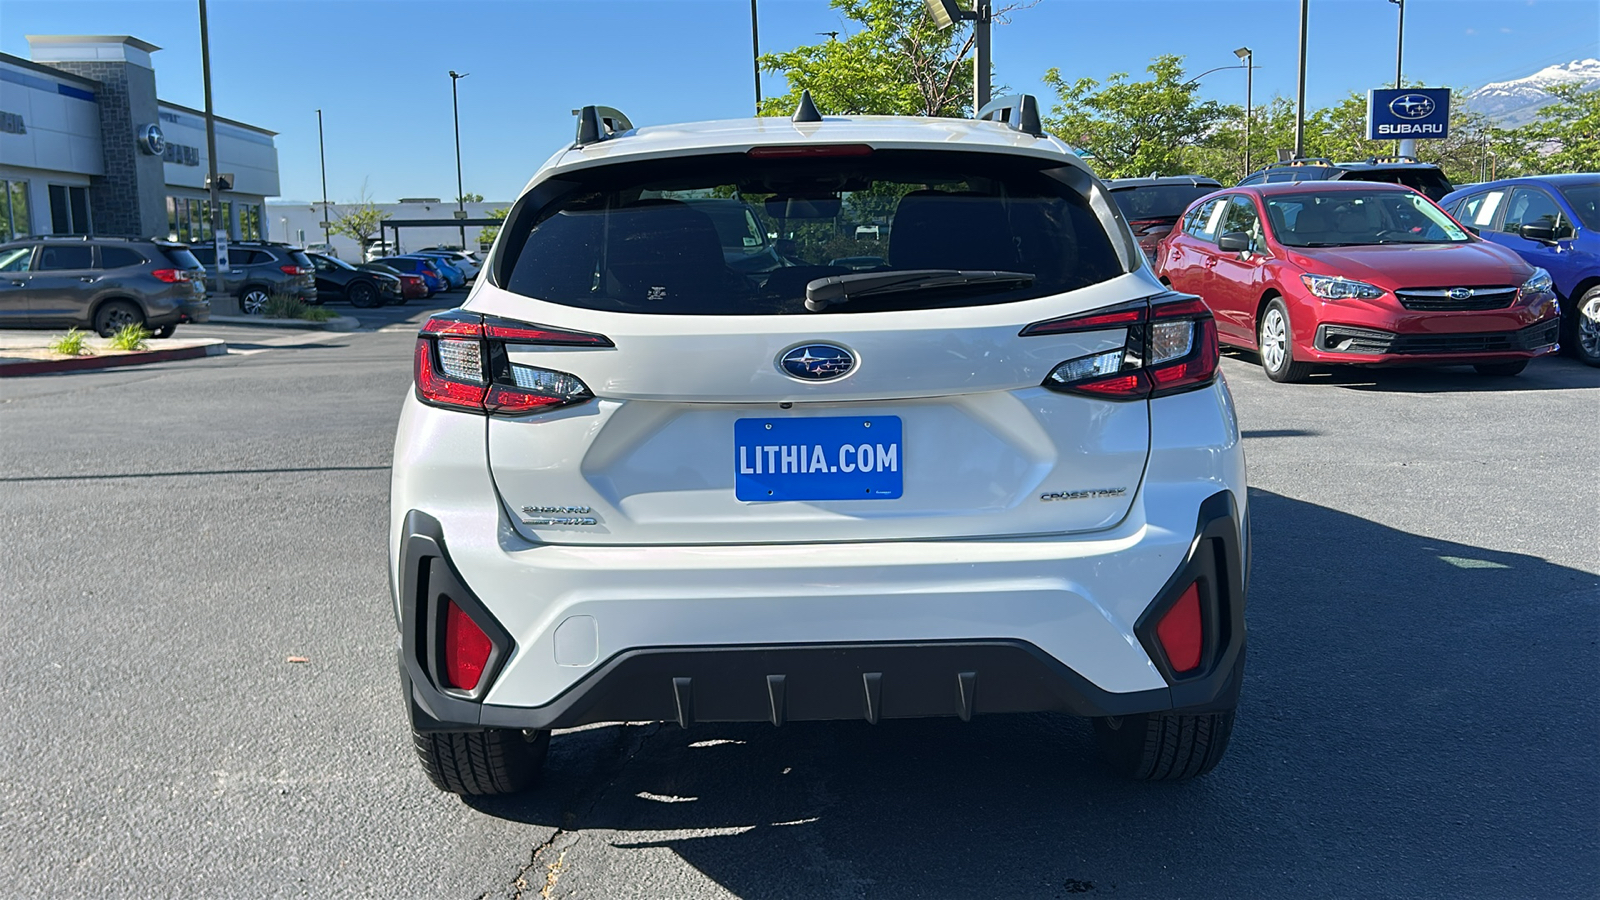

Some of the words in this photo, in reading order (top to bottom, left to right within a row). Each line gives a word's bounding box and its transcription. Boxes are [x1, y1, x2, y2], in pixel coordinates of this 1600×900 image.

[1378, 123, 1443, 134] SUBARU
[739, 443, 898, 474] LITHIA.COM
[1040, 486, 1127, 502] CROSSTREK
[521, 505, 591, 514] SUBARU
